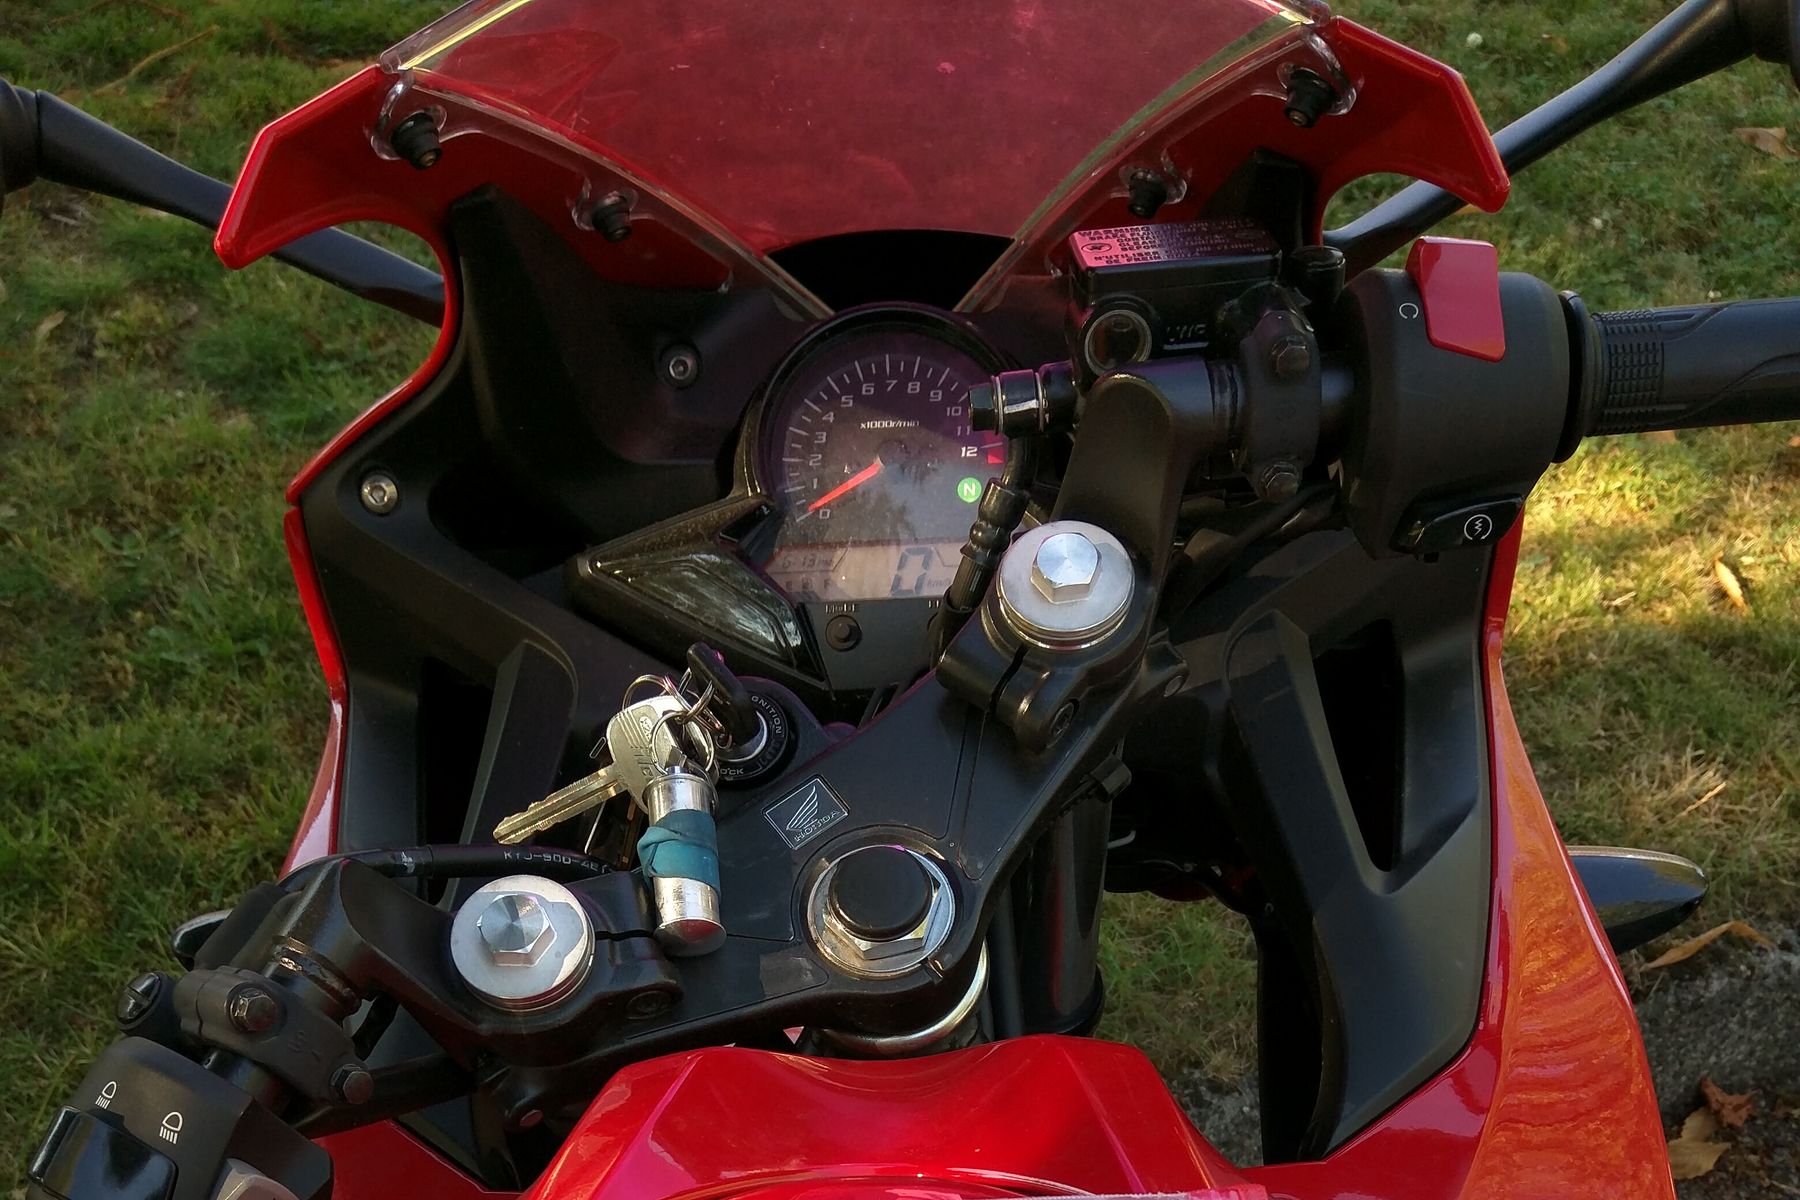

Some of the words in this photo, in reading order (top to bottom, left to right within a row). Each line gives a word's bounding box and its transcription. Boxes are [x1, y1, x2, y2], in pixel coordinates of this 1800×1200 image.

[861, 383, 875, 395] 6
[886, 380, 897, 392] 7
[907, 381, 921, 394] 8
[840, 395, 854, 407] 5
[929, 390, 943, 402] 9
[821, 411, 835, 422] 4
[946, 406, 962, 417] 10
[957, 425, 971, 436] 11
[814, 431, 827, 444] 3
[961, 446, 978, 457] 12
[808, 454, 822, 466] 2
[812, 478, 818, 489] 1
[963, 483, 976, 496] N
[819, 508, 831, 519] 0
[751, 695, 782, 735] GNITION
[720, 768, 744, 776] OCK
[793, 810, 841, 843] HONDA
